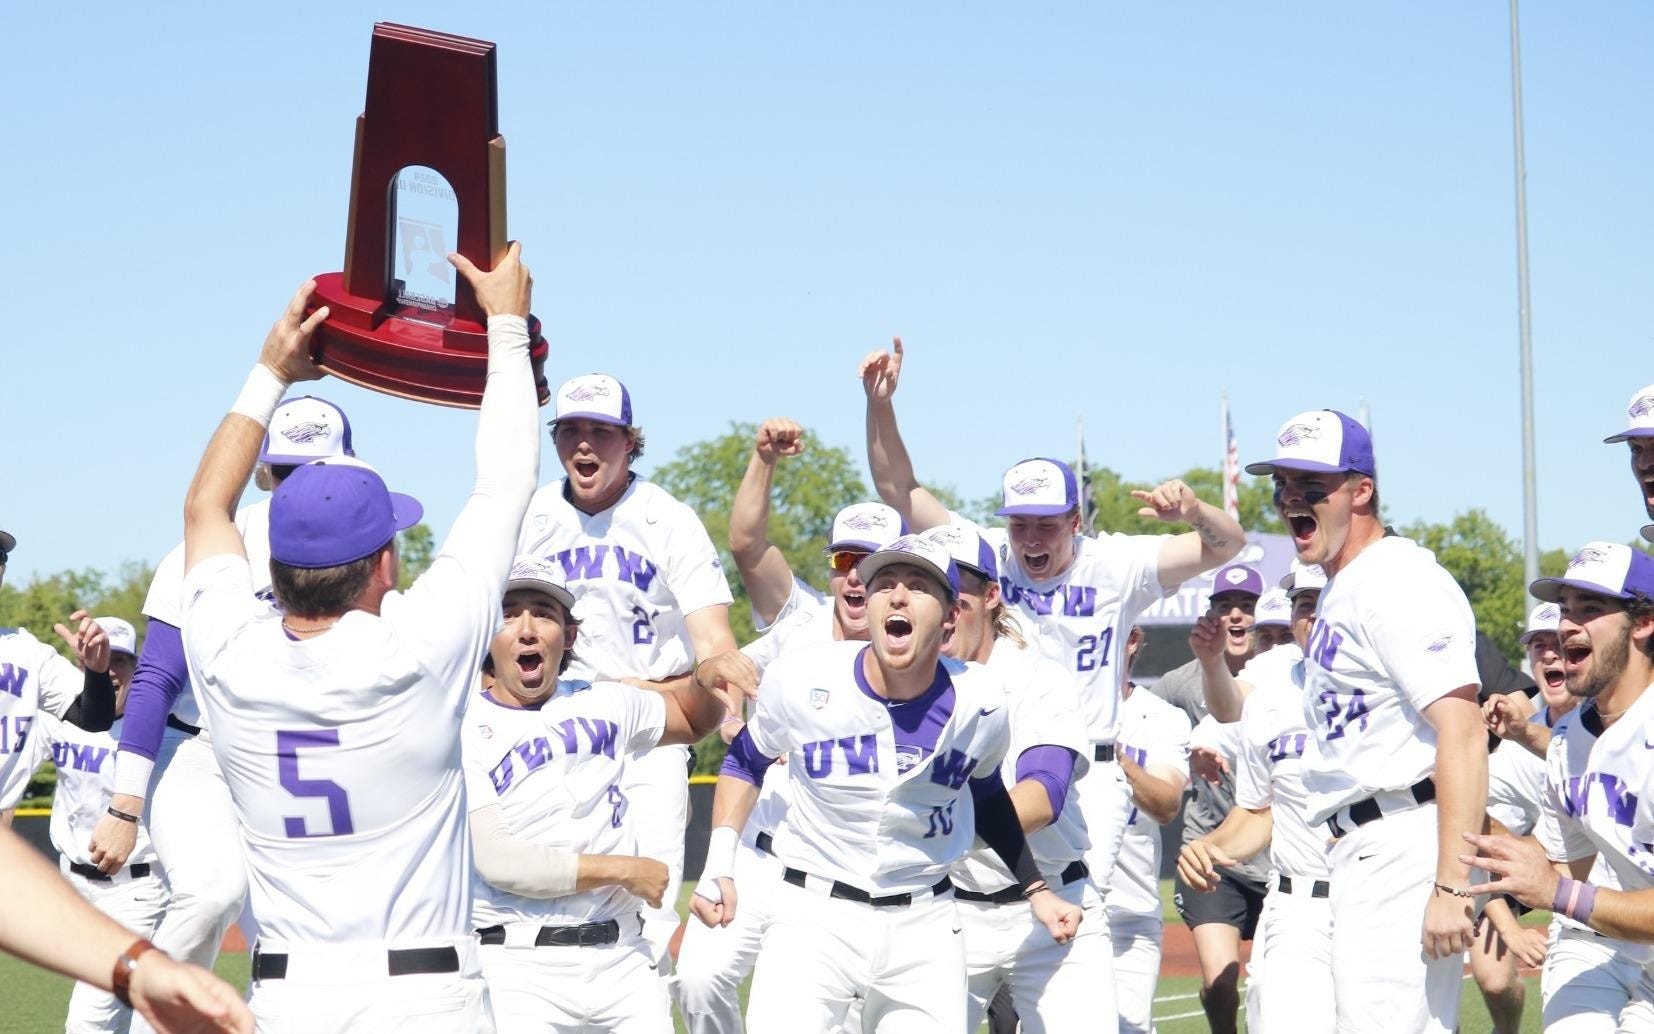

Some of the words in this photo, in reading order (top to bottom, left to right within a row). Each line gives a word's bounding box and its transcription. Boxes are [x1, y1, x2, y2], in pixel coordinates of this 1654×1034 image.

[544, 545, 657, 592] WW
[632, 605, 660, 645] 2
[1077, 627, 1113, 672] 27
[0, 716, 34, 754] 15
[1319, 688, 1370, 741] 24
[51, 741, 118, 775] UW
[276, 728, 355, 839] 5
